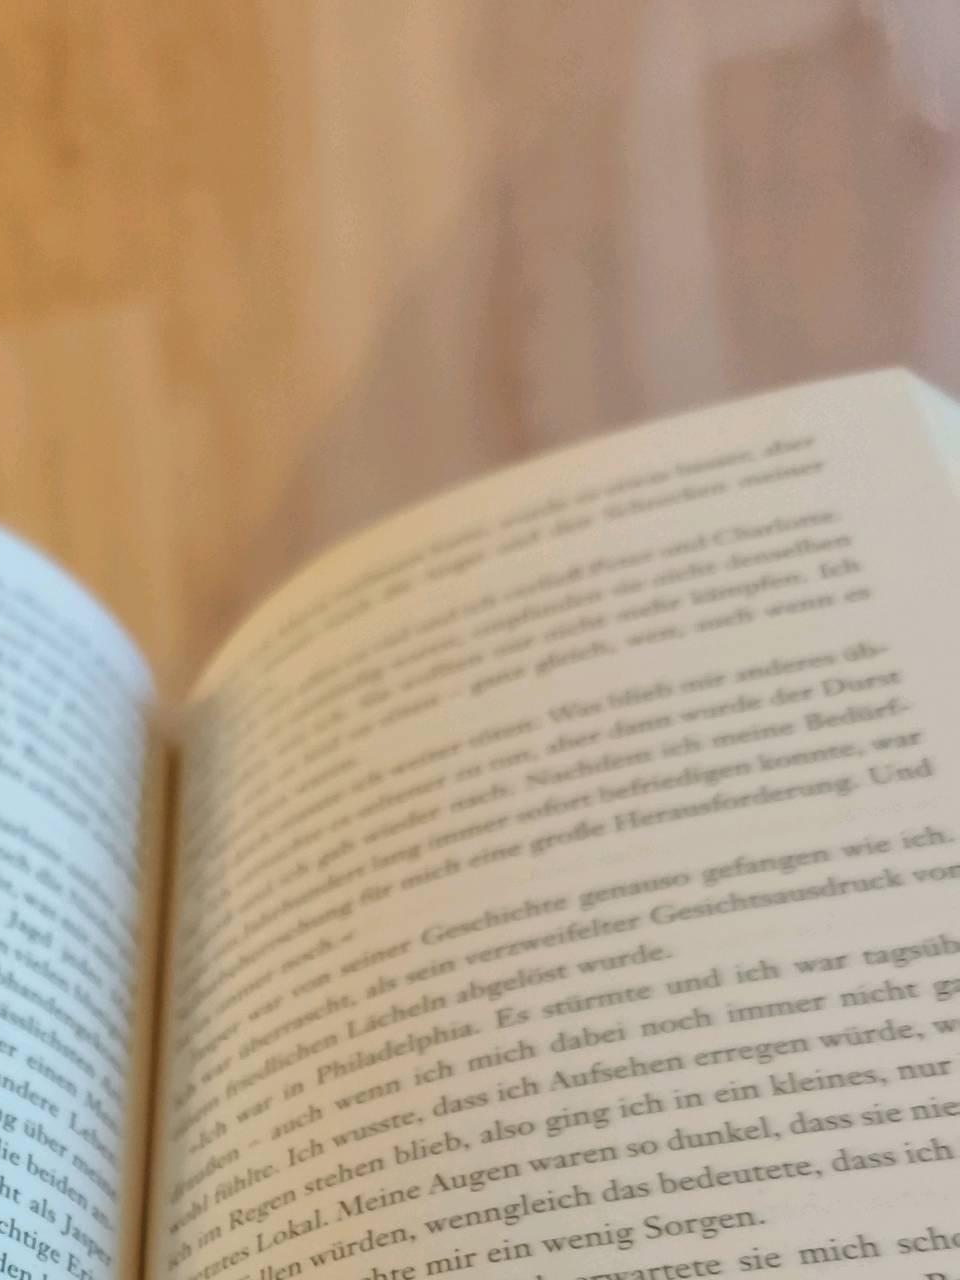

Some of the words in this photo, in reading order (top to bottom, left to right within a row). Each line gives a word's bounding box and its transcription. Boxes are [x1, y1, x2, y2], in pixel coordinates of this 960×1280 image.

[865, 756, 936, 786] Und
[335, 1185, 422, 1222] Meine
[427, 1162, 522, 1196] Augen
[526, 1145, 621, 1172] waren
[624, 1139, 661, 1158] so
[664, 1116, 783, 1152] dunkel,
[308, 1228, 418, 1268] würden,
[423, 1185, 595, 1234] wenngleich
[599, 1178, 654, 1203] das
[656, 1161, 824, 1194] bedeutete,
[829, 1148, 900, 1173] dass
[902, 1137, 957, 1165] ich
[424, 1248, 478, 1276] mir
[485, 1239, 534, 1264] ein
[540, 1223, 636, 1253] wenig
[641, 1211, 766, 1240] Sorgen.
[736, 1247, 783, 1272] sie
[797, 1234, 882, 1265] mich
